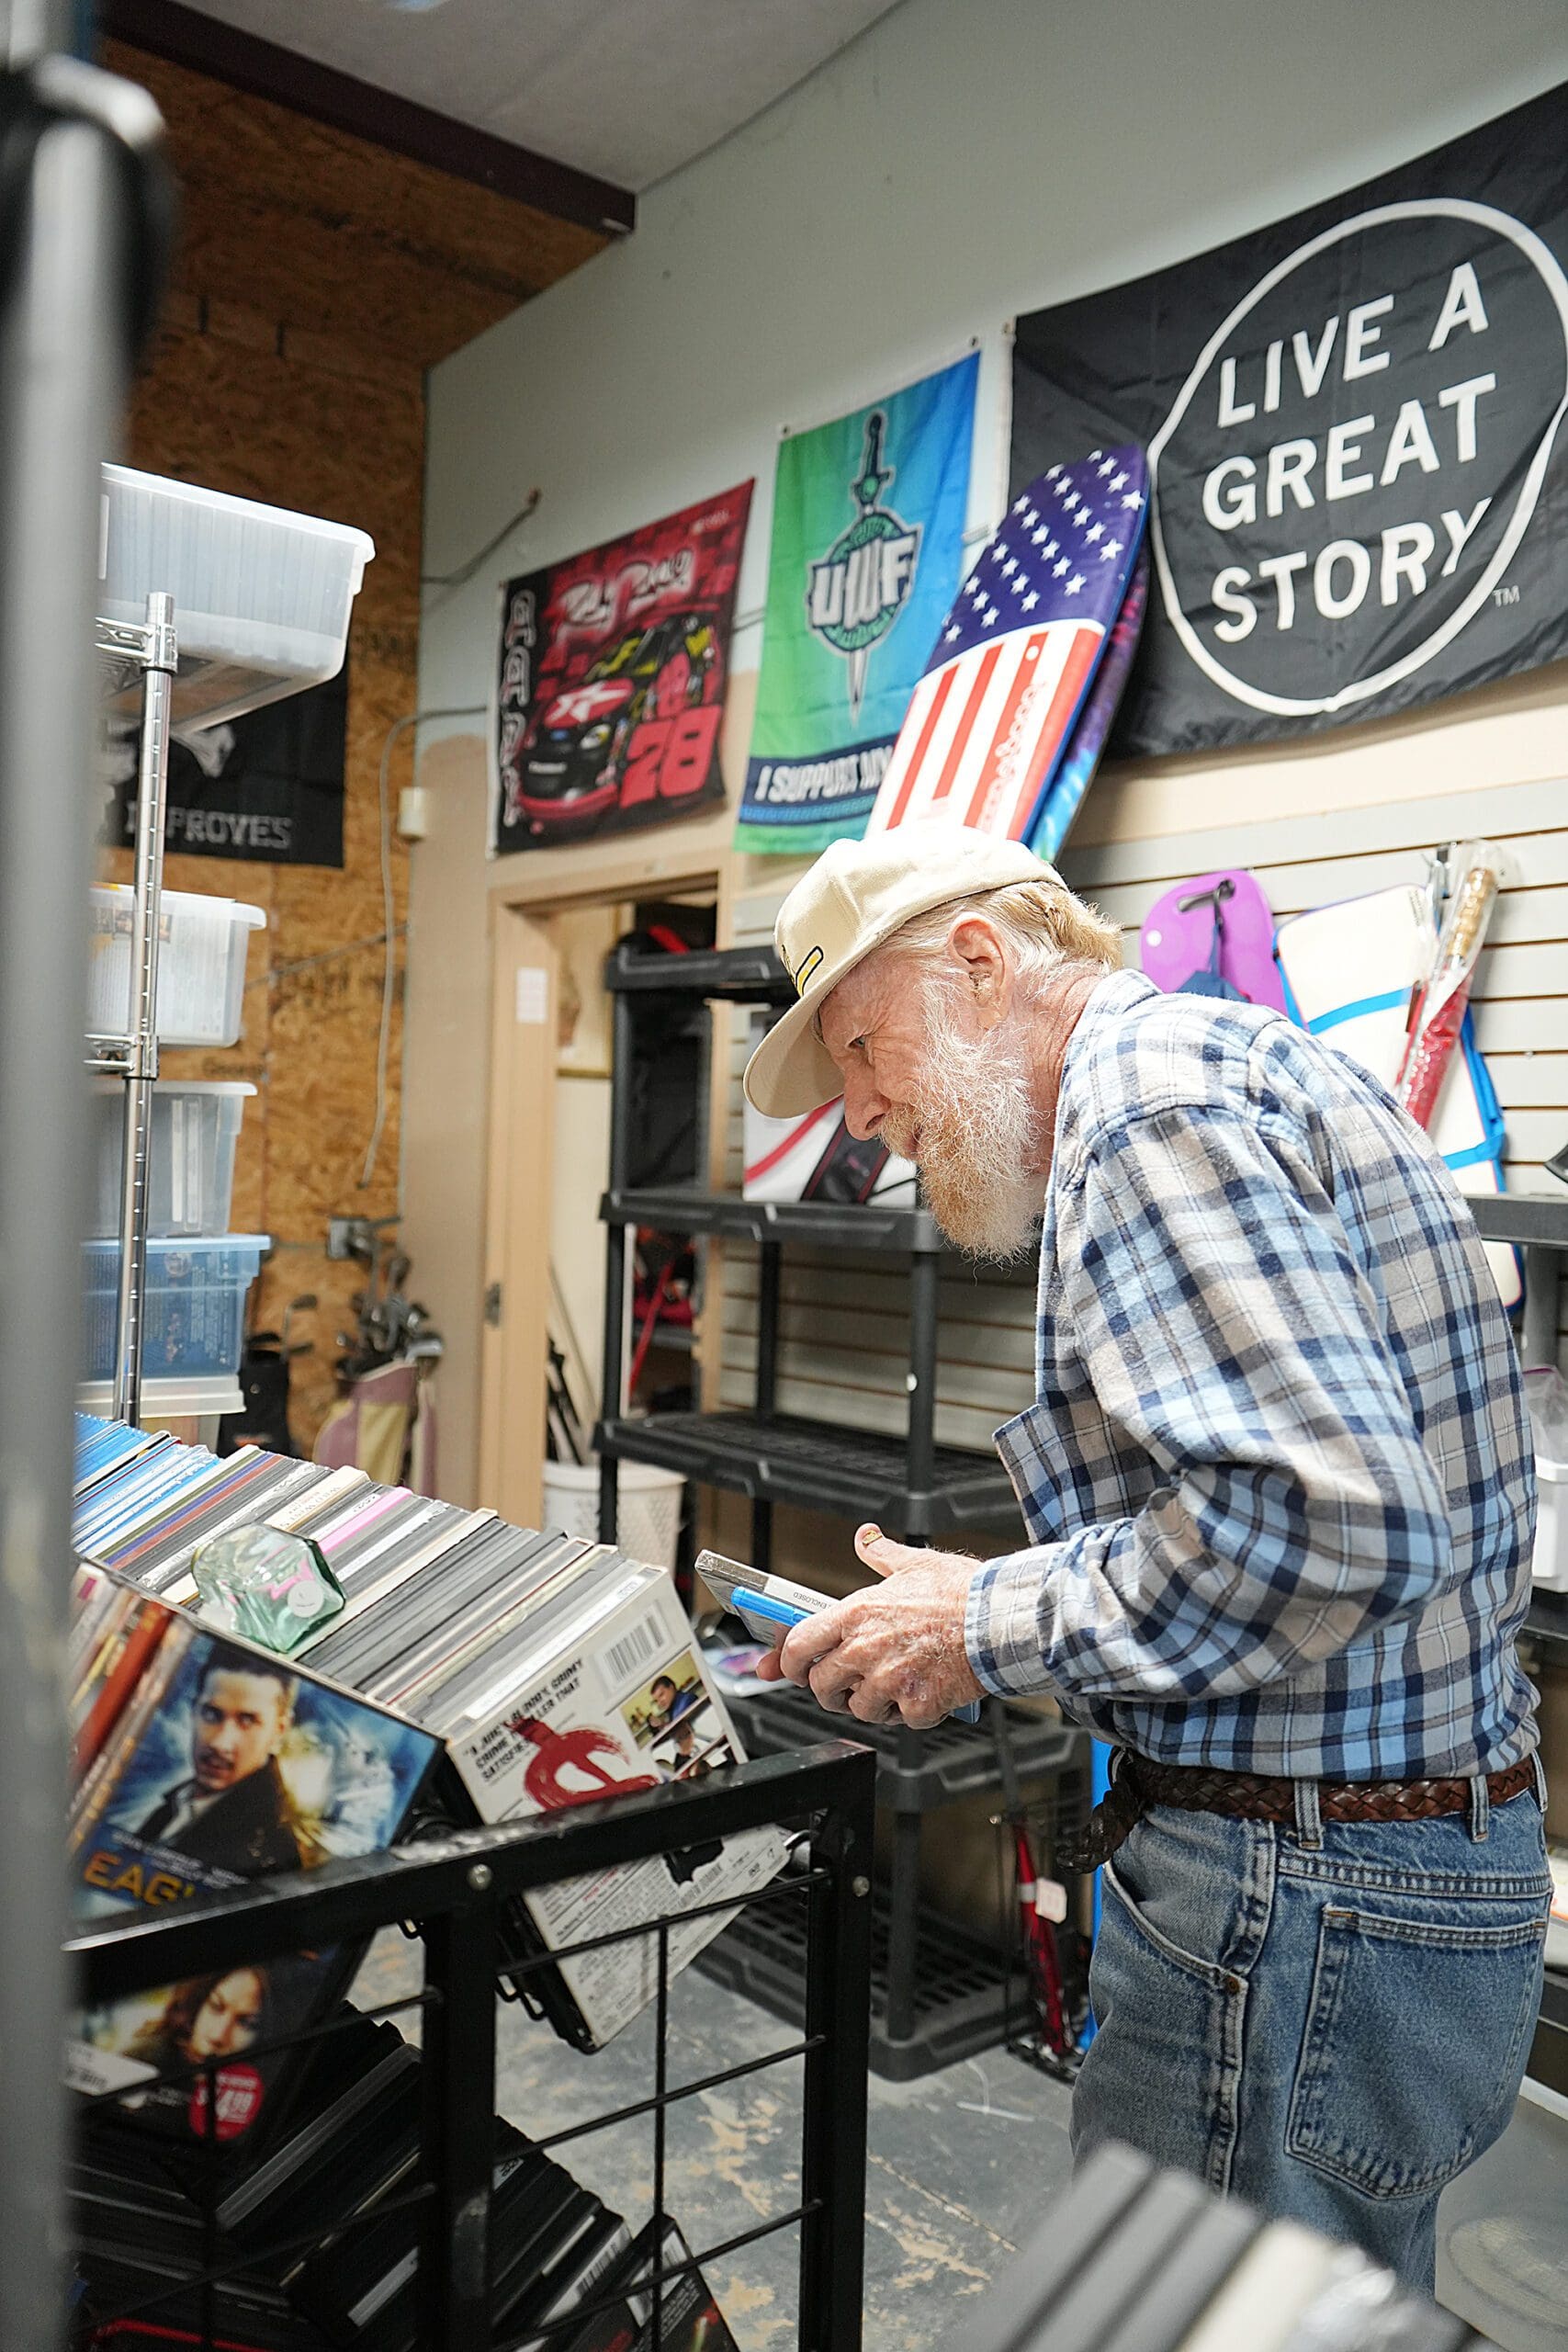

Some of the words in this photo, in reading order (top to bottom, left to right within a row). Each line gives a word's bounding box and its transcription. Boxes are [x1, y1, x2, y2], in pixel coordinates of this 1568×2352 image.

[1217, 294, 1394, 428] LIVE
[1429, 262, 1489, 352] A
[1202, 372, 1496, 531] GREAT
[812, 535, 918, 631] UWF
[1211, 496, 1493, 643] STORY
[619, 704, 722, 809] 28
[754, 764, 773, 801] I
[767, 753, 860, 802] SUPPORT
[126, 800, 292, 850] IPROVES
[793, 1591, 828, 1609] ENCLOSED
[84, 1850, 196, 1906] EAG
